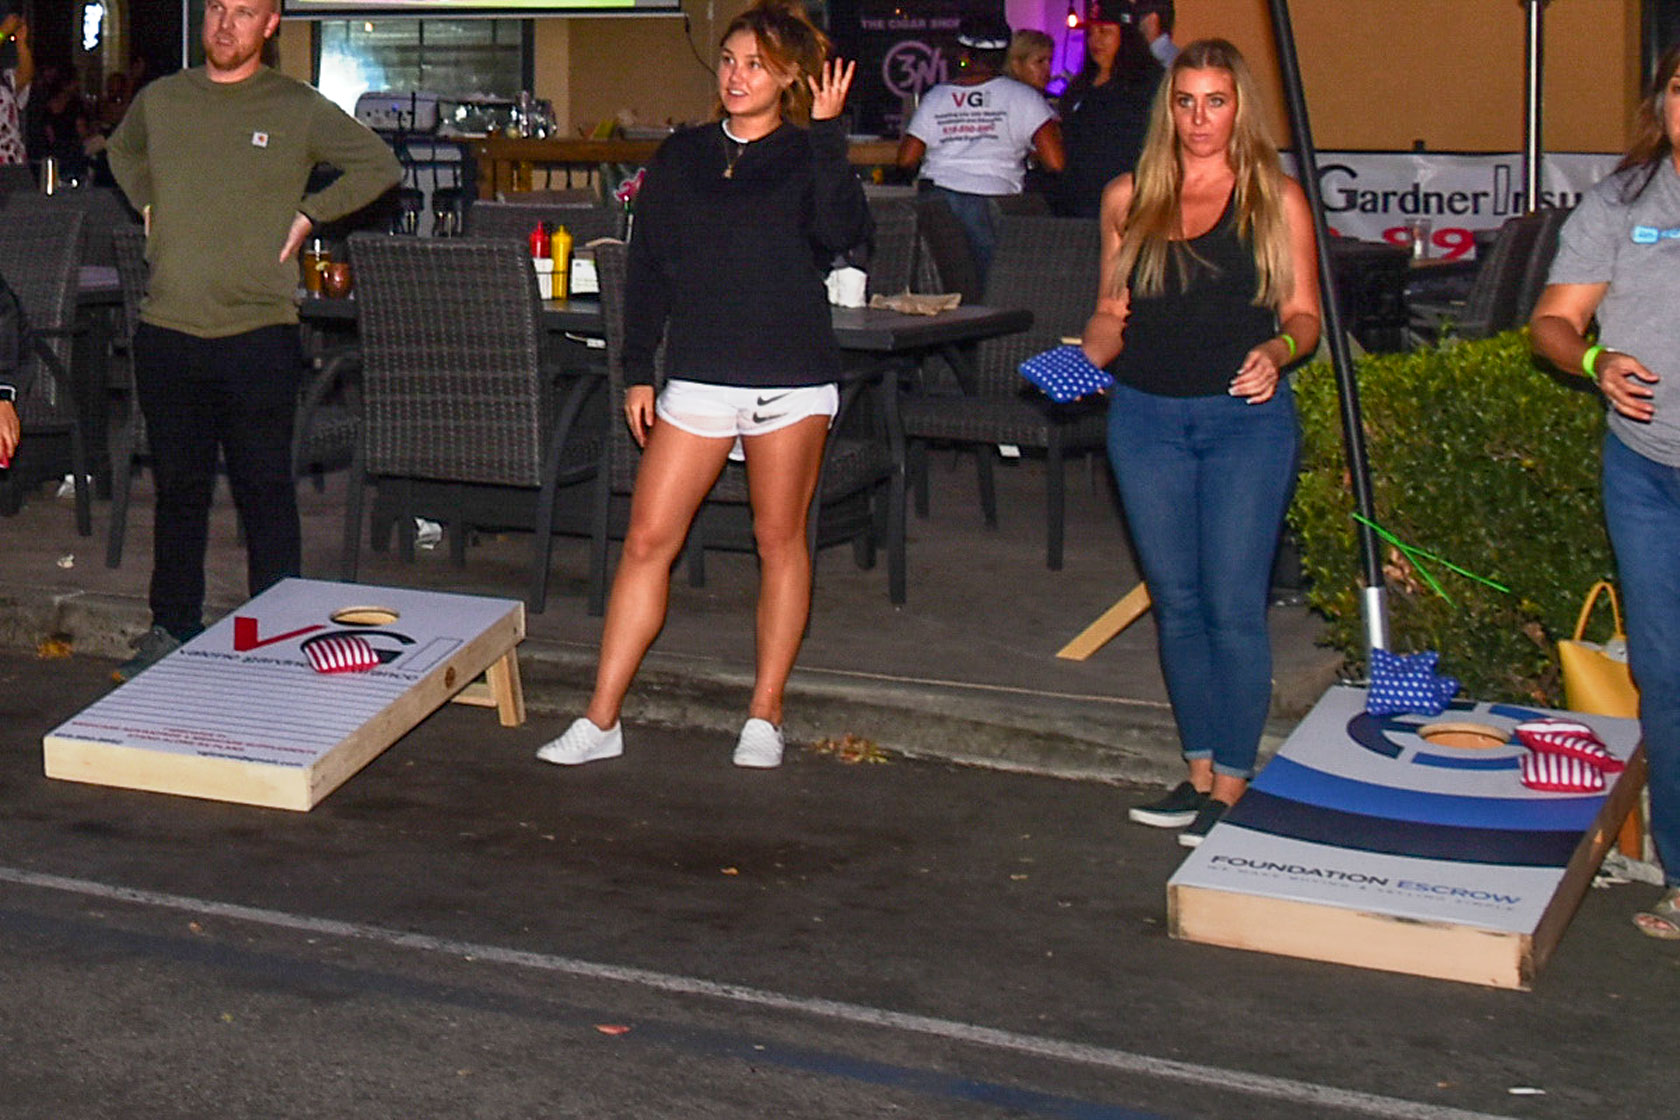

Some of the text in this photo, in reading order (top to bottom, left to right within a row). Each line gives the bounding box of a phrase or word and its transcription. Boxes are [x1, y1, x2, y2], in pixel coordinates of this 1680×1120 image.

[1318, 164, 1489, 215] Gardner
[1210, 854, 1522, 905] FOUNDATION ESCROW
